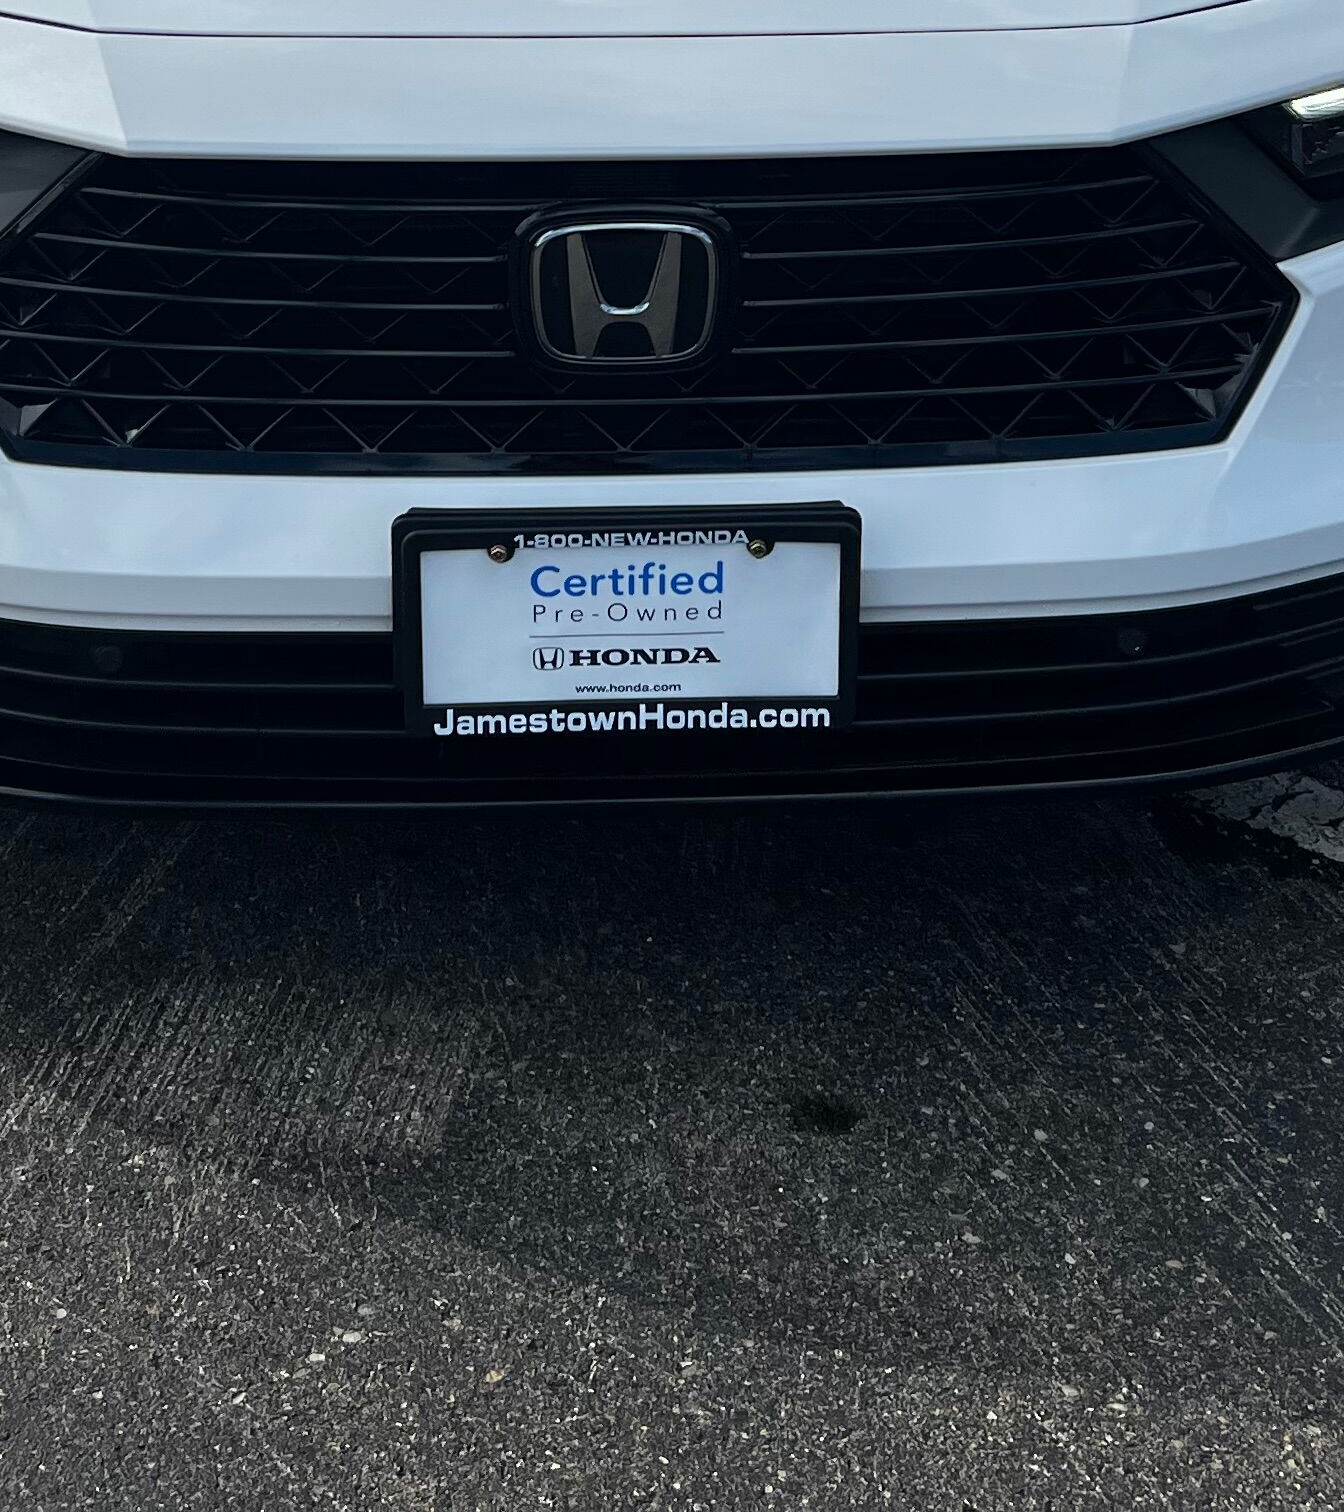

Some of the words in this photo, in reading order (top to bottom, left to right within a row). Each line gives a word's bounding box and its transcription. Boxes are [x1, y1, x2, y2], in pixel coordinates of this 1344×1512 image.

[513, 529, 750, 550] 1-800-NEW-HONDA
[530, 560, 724, 597] Certified
[532, 599, 722, 623] Pre-Owned
[569, 646, 721, 667] HONDA
[575, 683, 682, 694] www.honda.com
[434, 702, 830, 737] JamestownHonda.com
